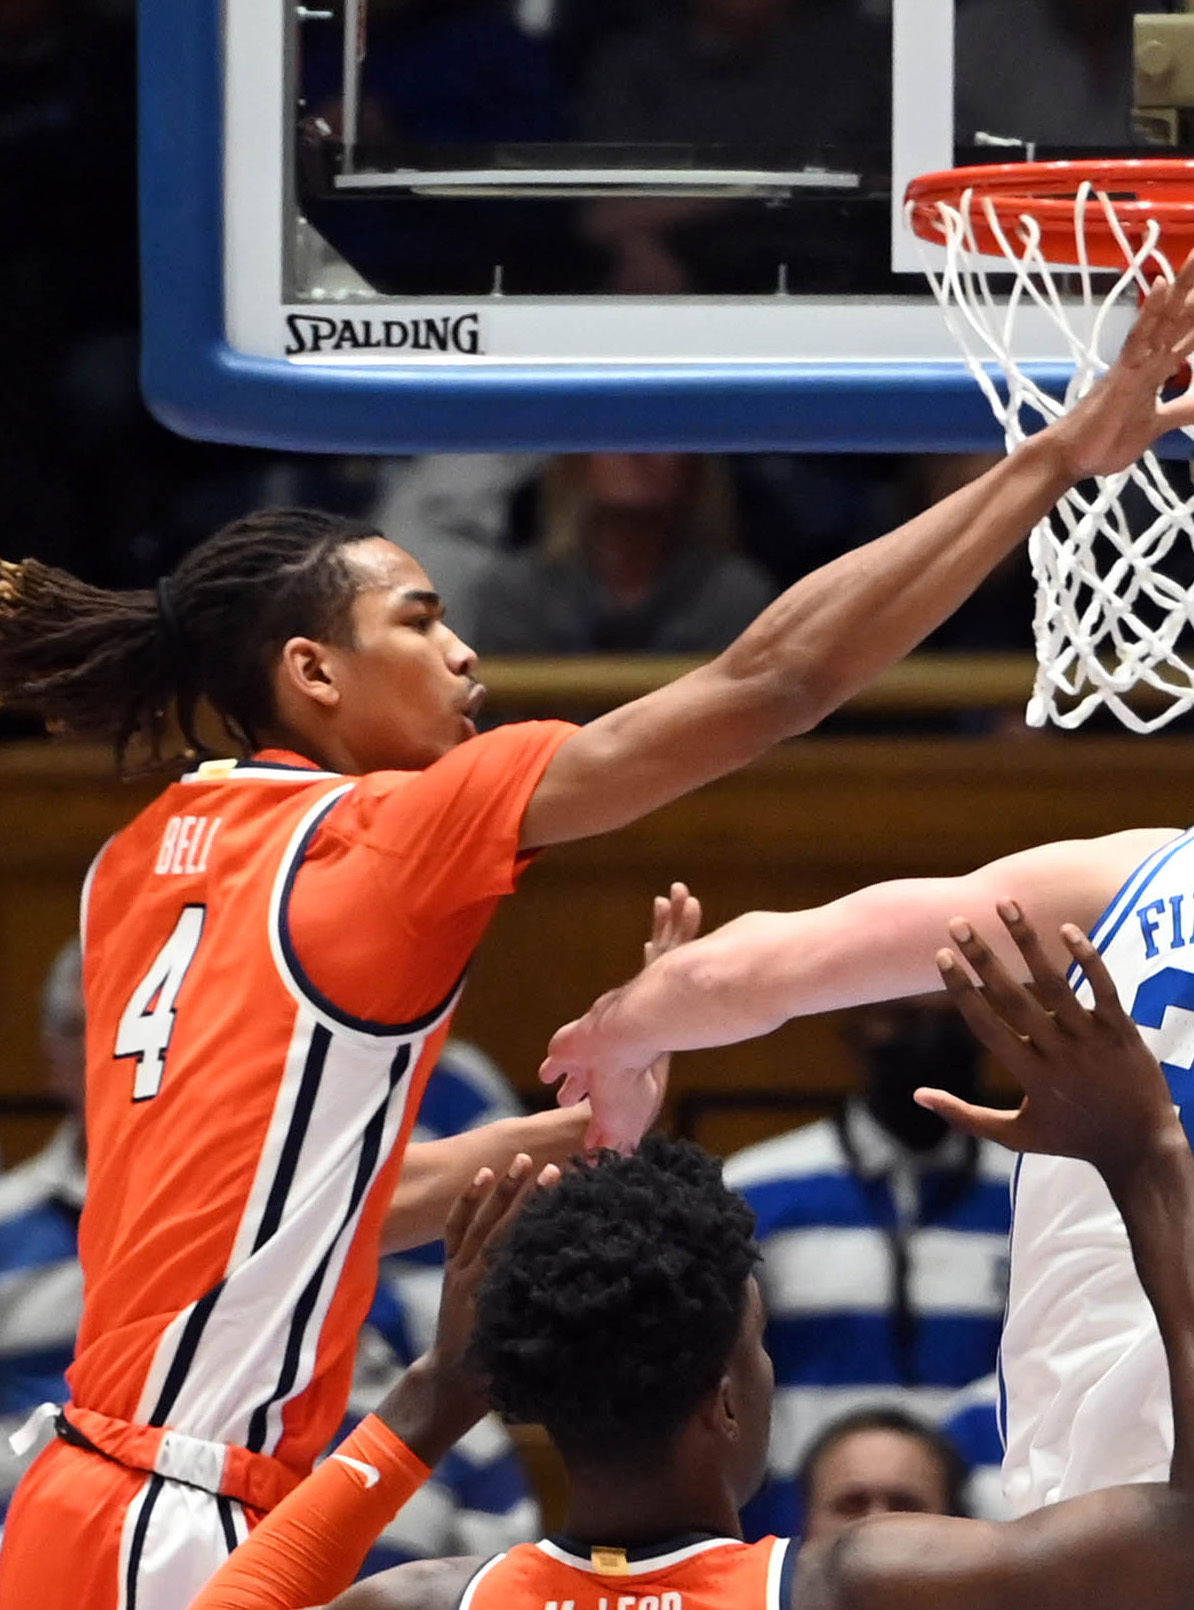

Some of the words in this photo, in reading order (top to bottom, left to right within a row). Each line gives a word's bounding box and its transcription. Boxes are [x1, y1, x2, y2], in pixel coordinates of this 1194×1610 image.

[286, 313, 479, 355] SPALDING
[153, 815, 223, 876] BELL
[113, 902, 207, 1104] 4
